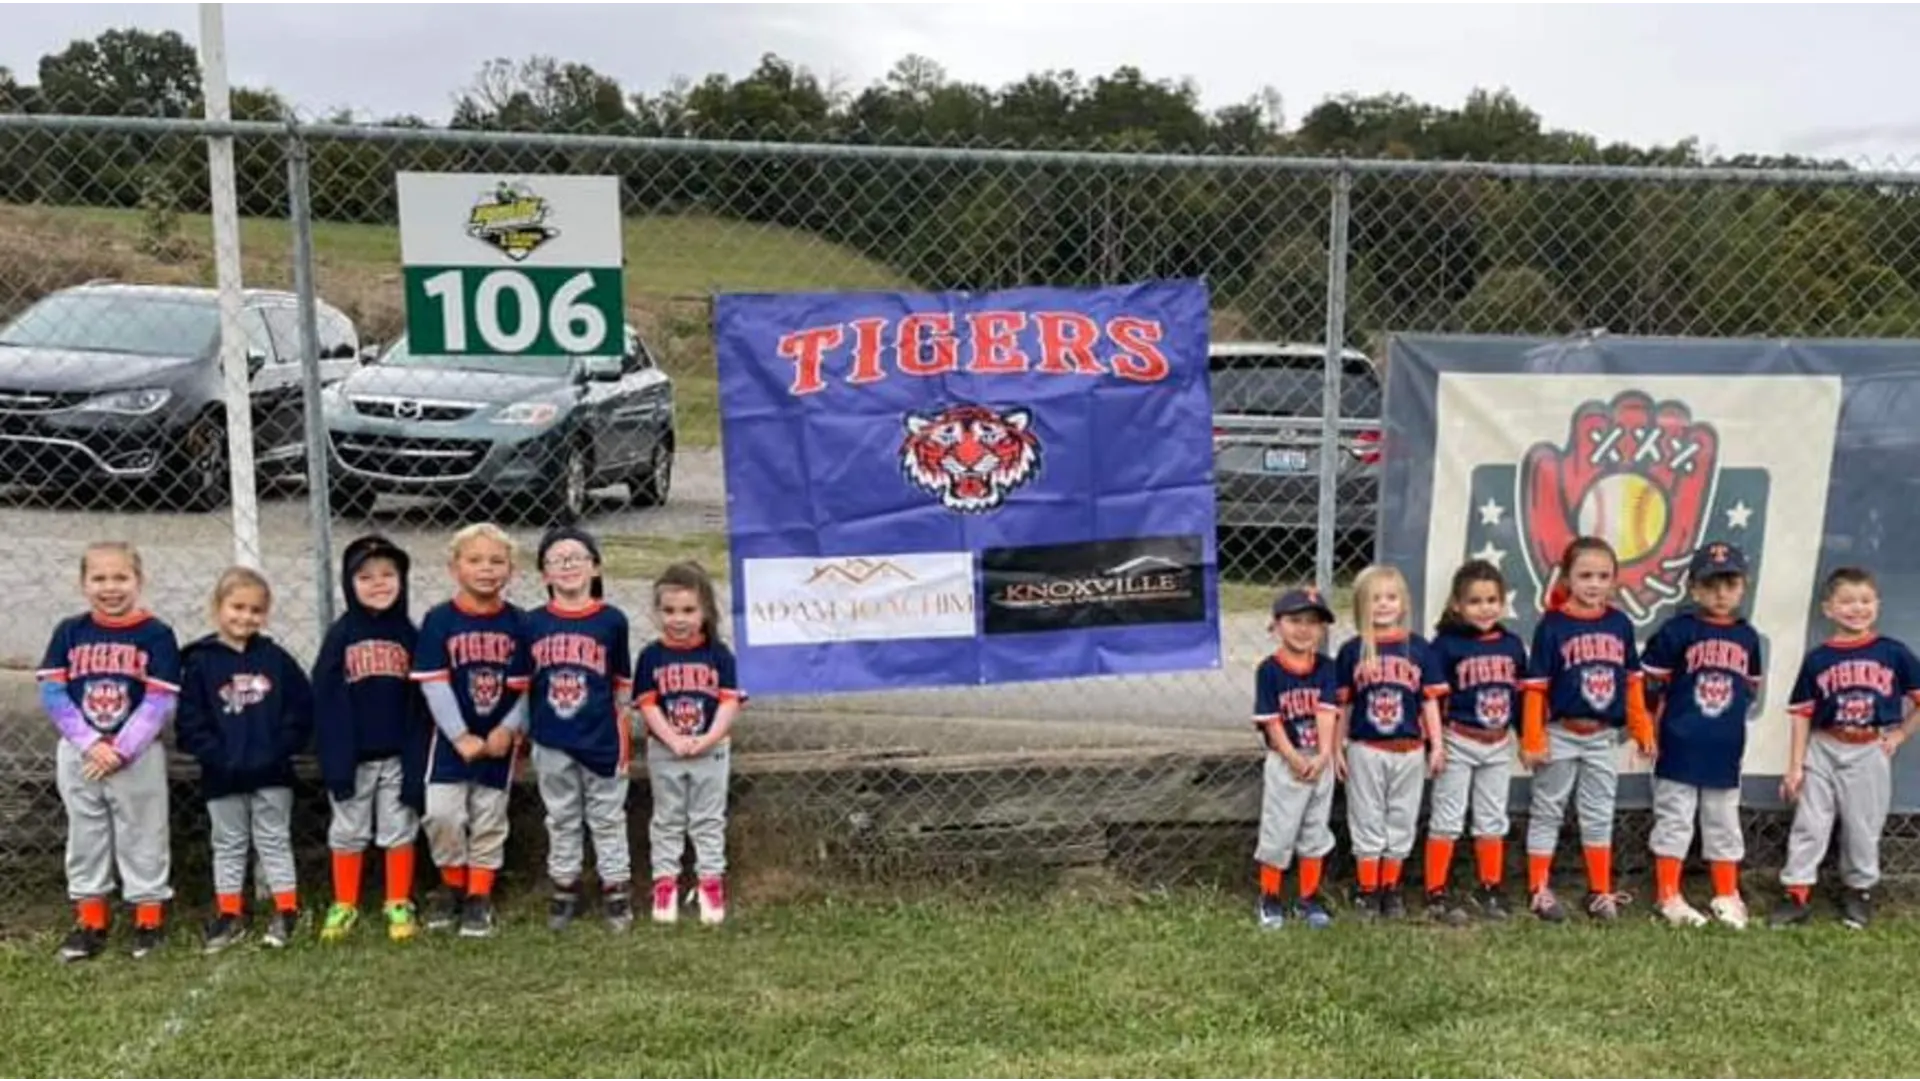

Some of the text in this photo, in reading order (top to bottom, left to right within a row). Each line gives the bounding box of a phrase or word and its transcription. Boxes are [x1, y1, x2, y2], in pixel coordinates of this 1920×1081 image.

[422, 268, 607, 353] 106
[777, 310, 1170, 396] TIGERS
[1004, 573, 1178, 602] KNOXVILLE
[752, 600, 838, 623] ADAM
[1816, 659, 1894, 698] TIGERS
